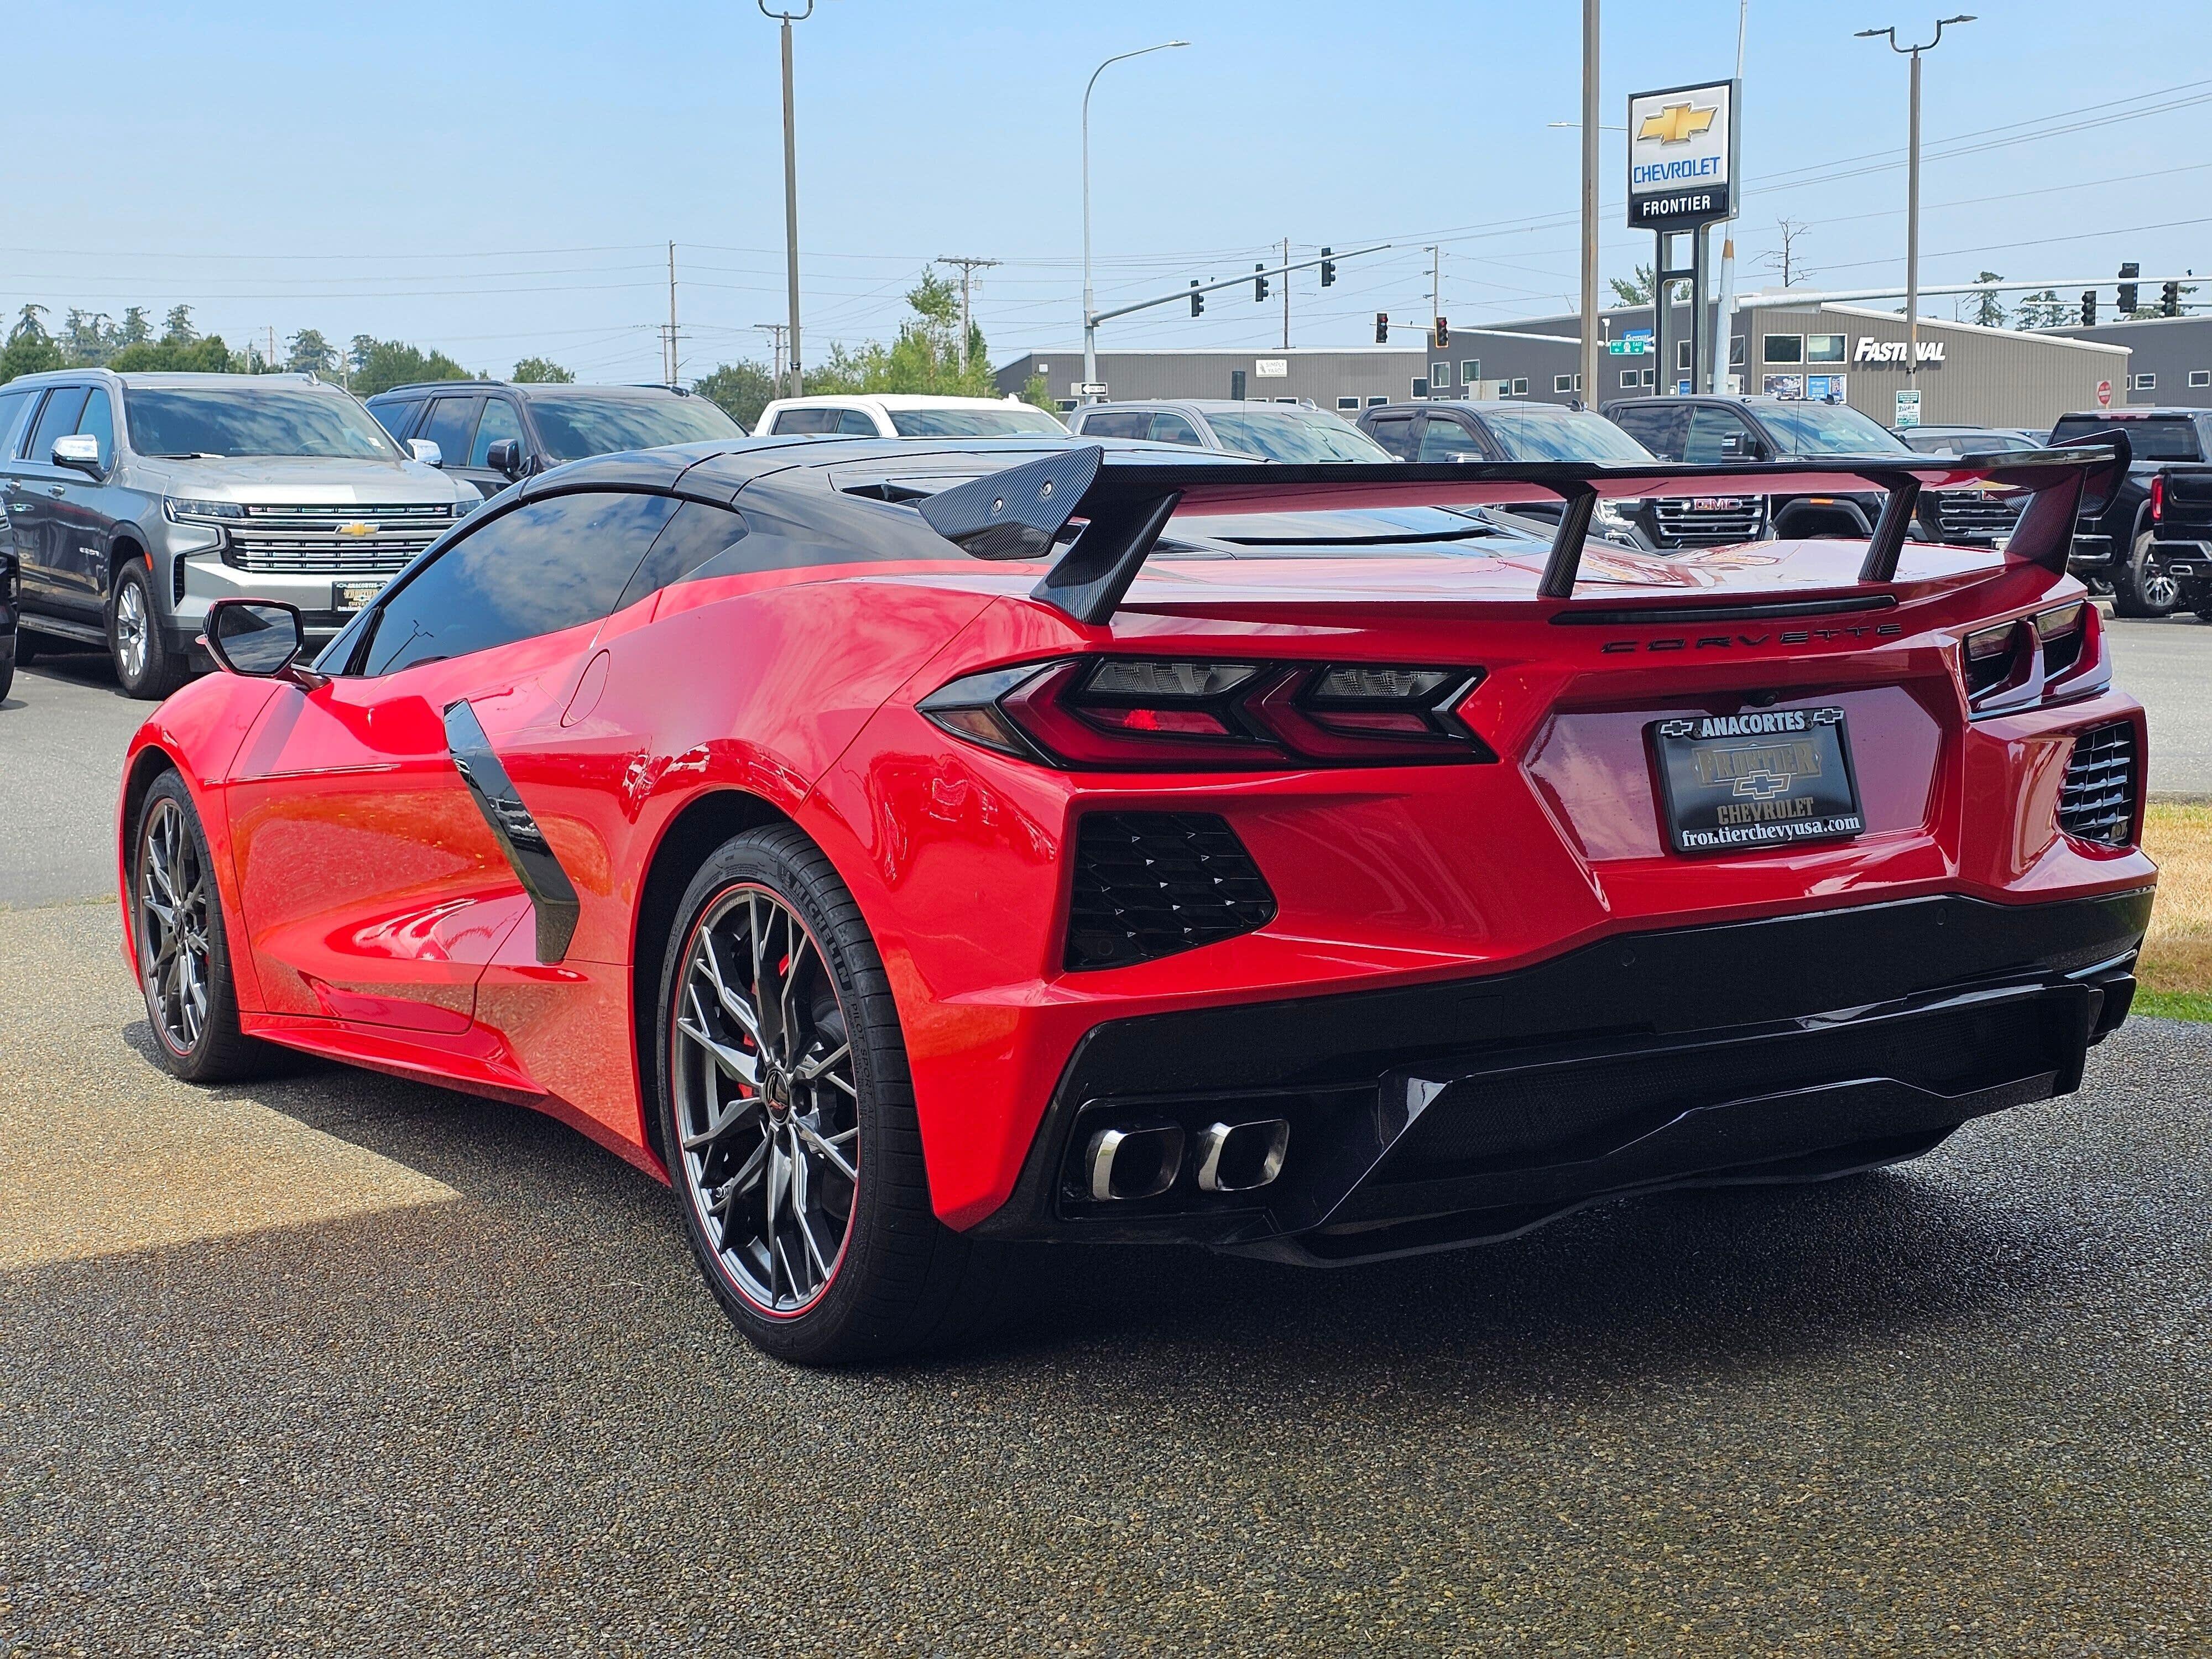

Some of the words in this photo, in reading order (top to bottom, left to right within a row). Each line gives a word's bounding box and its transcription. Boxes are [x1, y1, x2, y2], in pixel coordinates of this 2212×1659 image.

[1634, 156, 1720, 184] CHEVROLET
[1643, 195, 1711, 216] FRONTIER
[1693, 498, 1739, 510] GMC
[1601, 623, 1902, 653] CORVETTE
[1701, 711, 1806, 737] ANACORTES
[1696, 742, 1819, 783] FRONTIER
[1717, 797, 1814, 825] CHEVROLET
[1682, 816, 1861, 847] frontierchevyusa.com
[792, 880, 850, 984] MICHELIN
[851, 1003, 865, 1042] PILOT
[860, 1048, 873, 1099] SPORT
